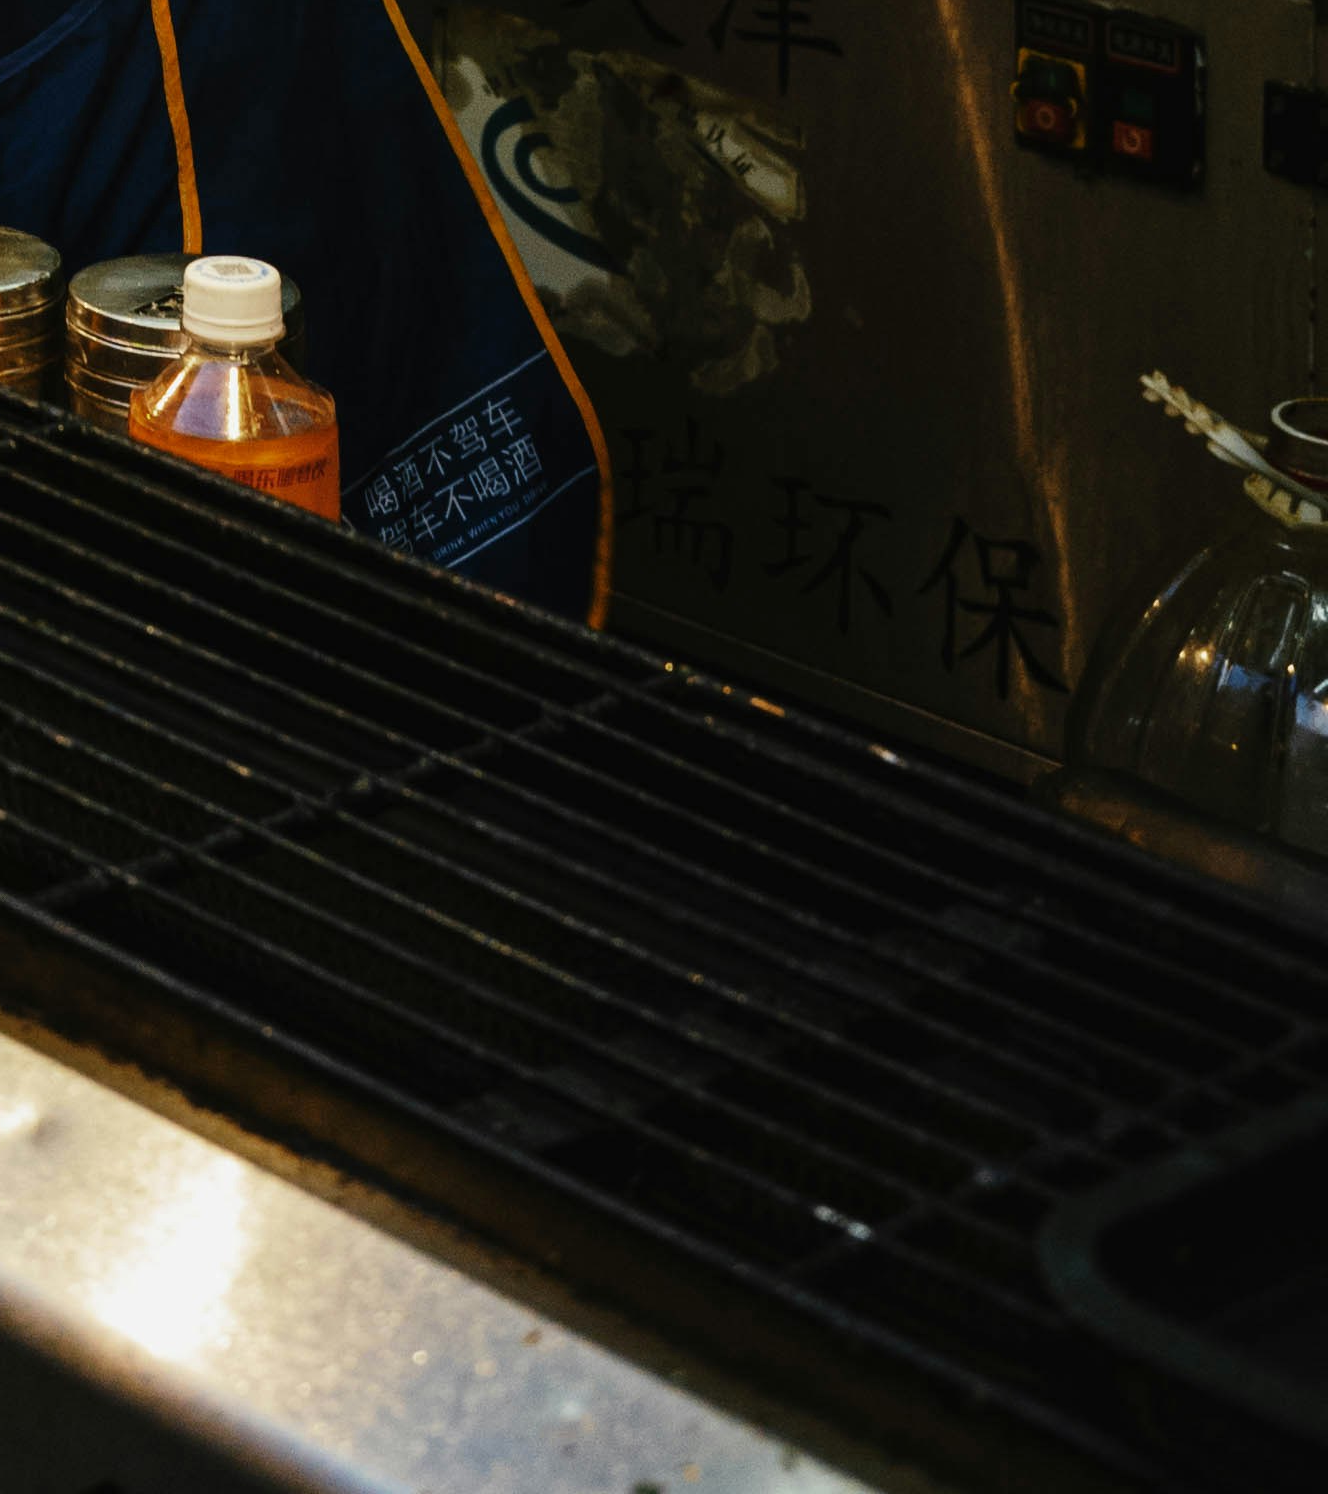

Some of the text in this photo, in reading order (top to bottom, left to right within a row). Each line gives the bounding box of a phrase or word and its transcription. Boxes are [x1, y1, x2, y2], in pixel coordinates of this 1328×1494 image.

[364, 396, 523, 518] 喝酒不驾车
[378, 433, 543, 554] 驾车不喝酒
[616, 415, 1072, 702] 瑞环保
